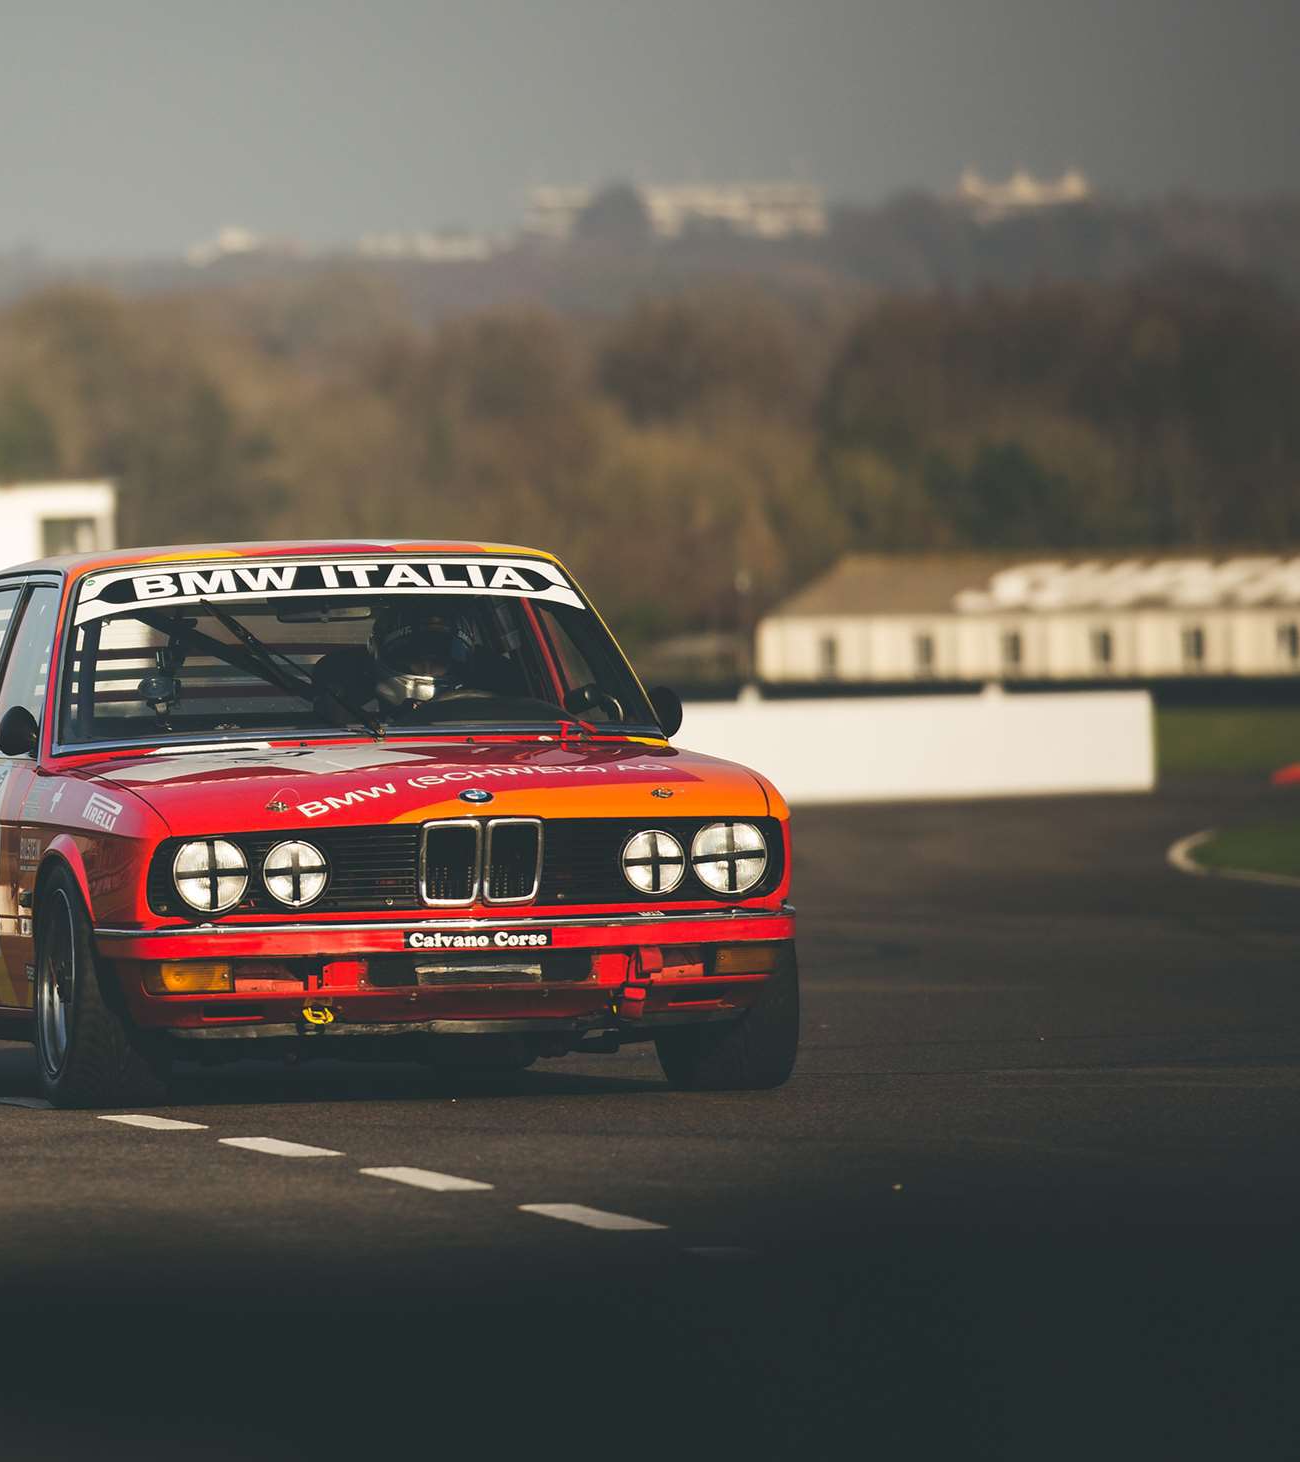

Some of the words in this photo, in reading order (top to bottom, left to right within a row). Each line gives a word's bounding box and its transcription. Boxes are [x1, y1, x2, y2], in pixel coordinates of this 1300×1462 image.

[132, 566, 298, 601] BMW
[319, 564, 535, 591] ITALIA
[296, 783, 397, 818] BMW
[407, 764, 607, 789] (SCHWEIZ)
[617, 763, 672, 772] AG
[82, 792, 123, 832] PIRELLI
[409, 932, 489, 948] Calvano
[494, 931, 548, 947] Corse
